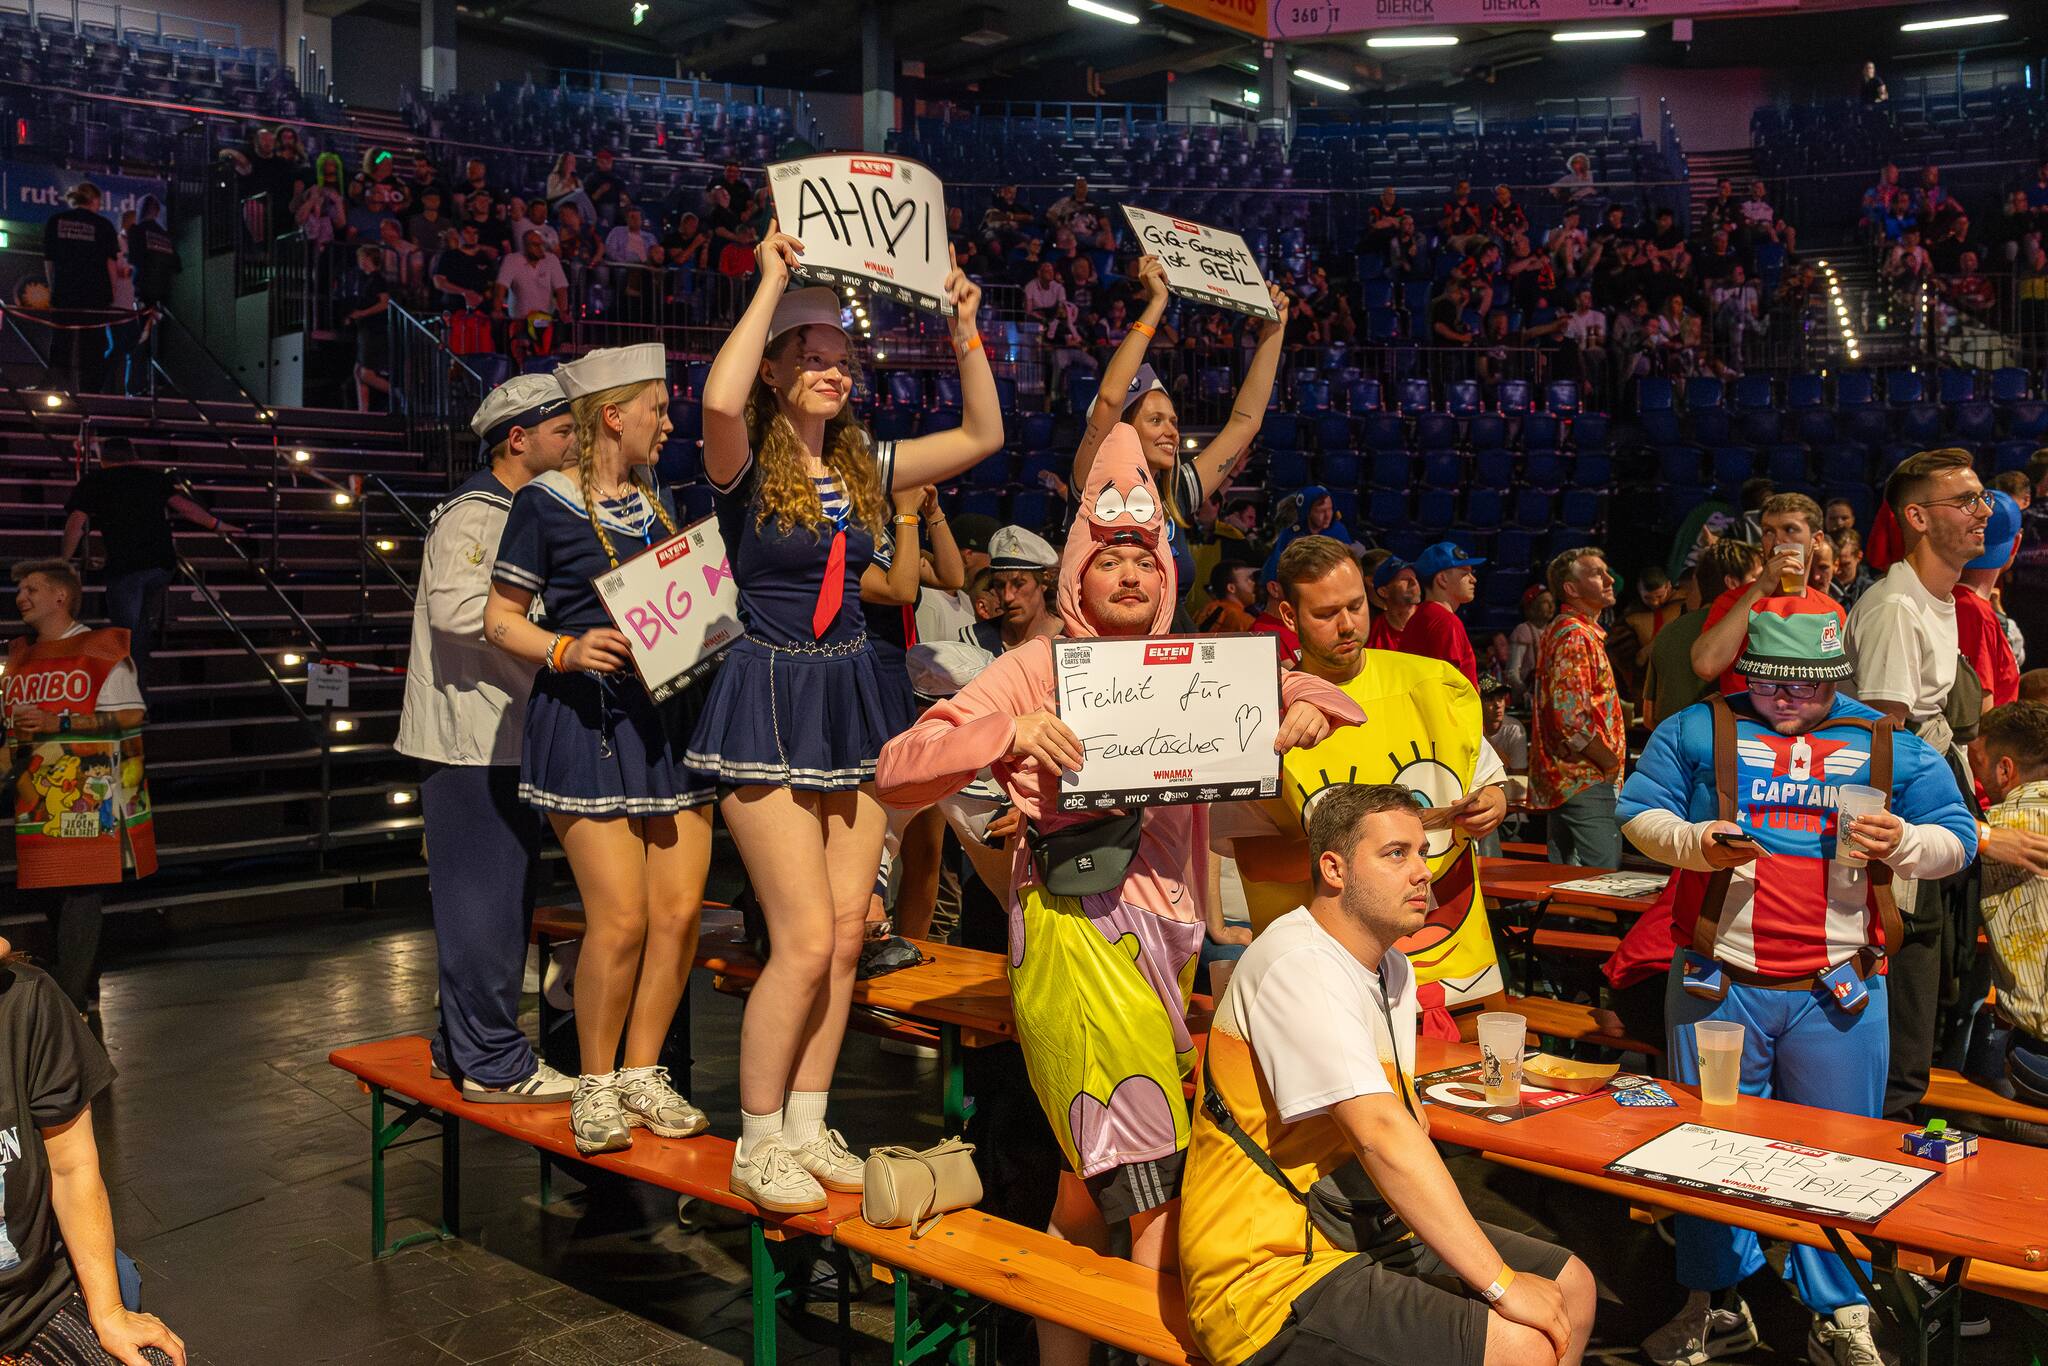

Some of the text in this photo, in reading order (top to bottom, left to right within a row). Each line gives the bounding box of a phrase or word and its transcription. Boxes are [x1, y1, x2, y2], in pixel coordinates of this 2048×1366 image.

[1376, 0, 1434, 14] DIERCK
[1199, 258, 1260, 287] GEIL
[624, 580, 693, 651] BIG
[1148, 647, 1190, 657] ELTEN
[1064, 673, 1154, 711] Freiheit
[1153, 769, 1193, 780] WINAMAX
[1125, 794, 1149, 803] HYLO
[1231, 787, 1255, 797] HOLY
[1752, 779, 1842, 808] CAPTAIN
[1066, 798, 1085, 808] PDC
[1692, 1139, 1827, 1175] MEHR
[1677, 1179, 1705, 1188] HYLO
[1698, 1156, 1899, 1207] FREIBIER
[1722, 1178, 1770, 1191] WINAMAX
